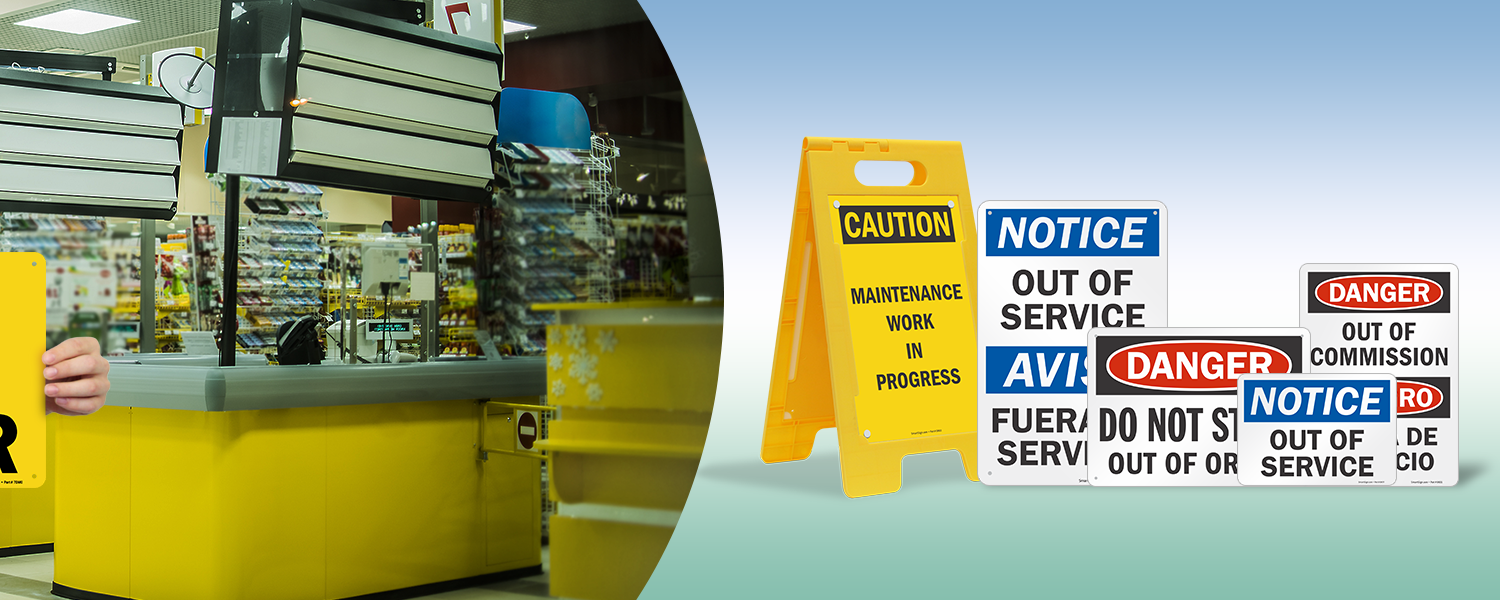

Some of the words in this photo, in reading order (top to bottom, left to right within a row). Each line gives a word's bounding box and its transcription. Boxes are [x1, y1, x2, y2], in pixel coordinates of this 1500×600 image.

[844, 211, 950, 238] CAUTION
[998, 217, 1147, 248] NOTICE
[851, 284, 963, 304] MAINTENANCE
[1013, 270, 1079, 296] OUT
[1089, 270, 1133, 296] OF
[1330, 283, 1430, 302] DANGER
[886, 313, 934, 331] WORK
[1001, 304, 1145, 330] SERVICE
[1343, 322, 1382, 340] OUT
[1390, 322, 1416, 340] OF
[906, 342, 923, 359] IN
[1312, 347, 1448, 366] COMMISSION
[1003, 353, 1087, 387] AVI
[1128, 352, 1273, 379] DANGER
[876, 368, 961, 390] PROGRESS
[1251, 387, 1383, 415] NOTICE
[1100, 407, 1137, 442] DO
[1149, 407, 1203, 442] NOT
[1270, 430, 1322, 450] OUT
[1330, 430, 1364, 450] OF
[1407, 428, 1437, 445] DE
[1109, 452, 1156, 474] OUT
[1166, 452, 1197, 474] OF
[1261, 456, 1373, 477] SERVICE
